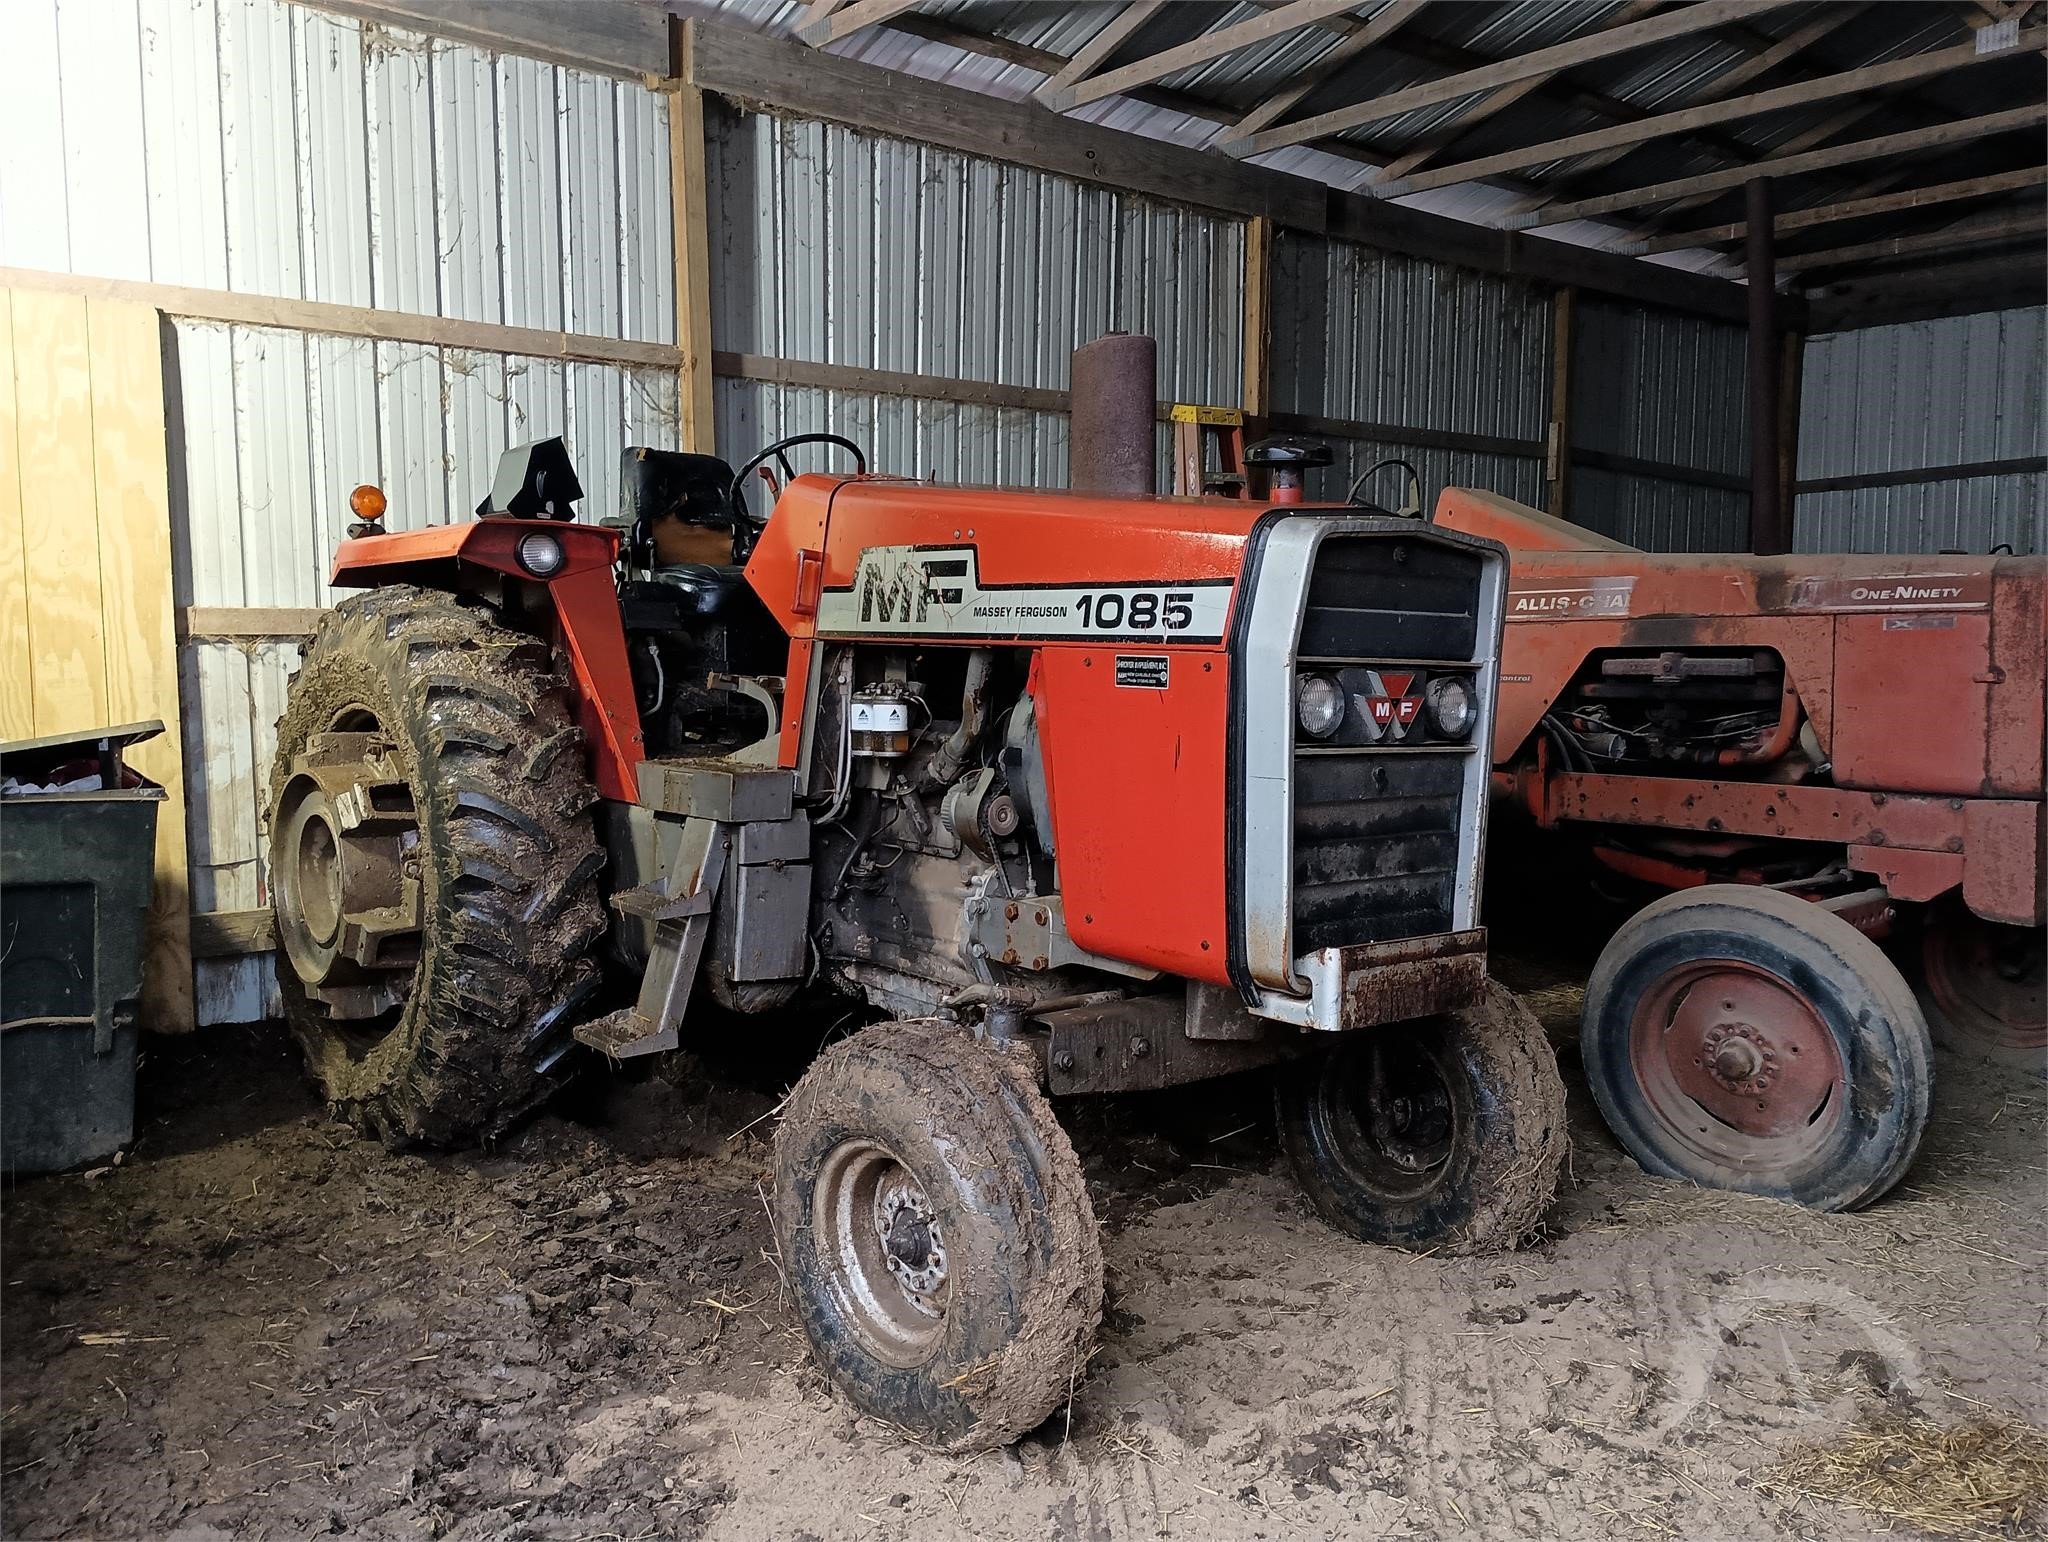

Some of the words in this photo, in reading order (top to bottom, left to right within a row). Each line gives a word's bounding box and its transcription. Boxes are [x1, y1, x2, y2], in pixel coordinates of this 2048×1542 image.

[973, 606, 1012, 617] MASSEY
[1014, 606, 1068, 617] FERGUSON
[1075, 593, 1194, 629] 1085
